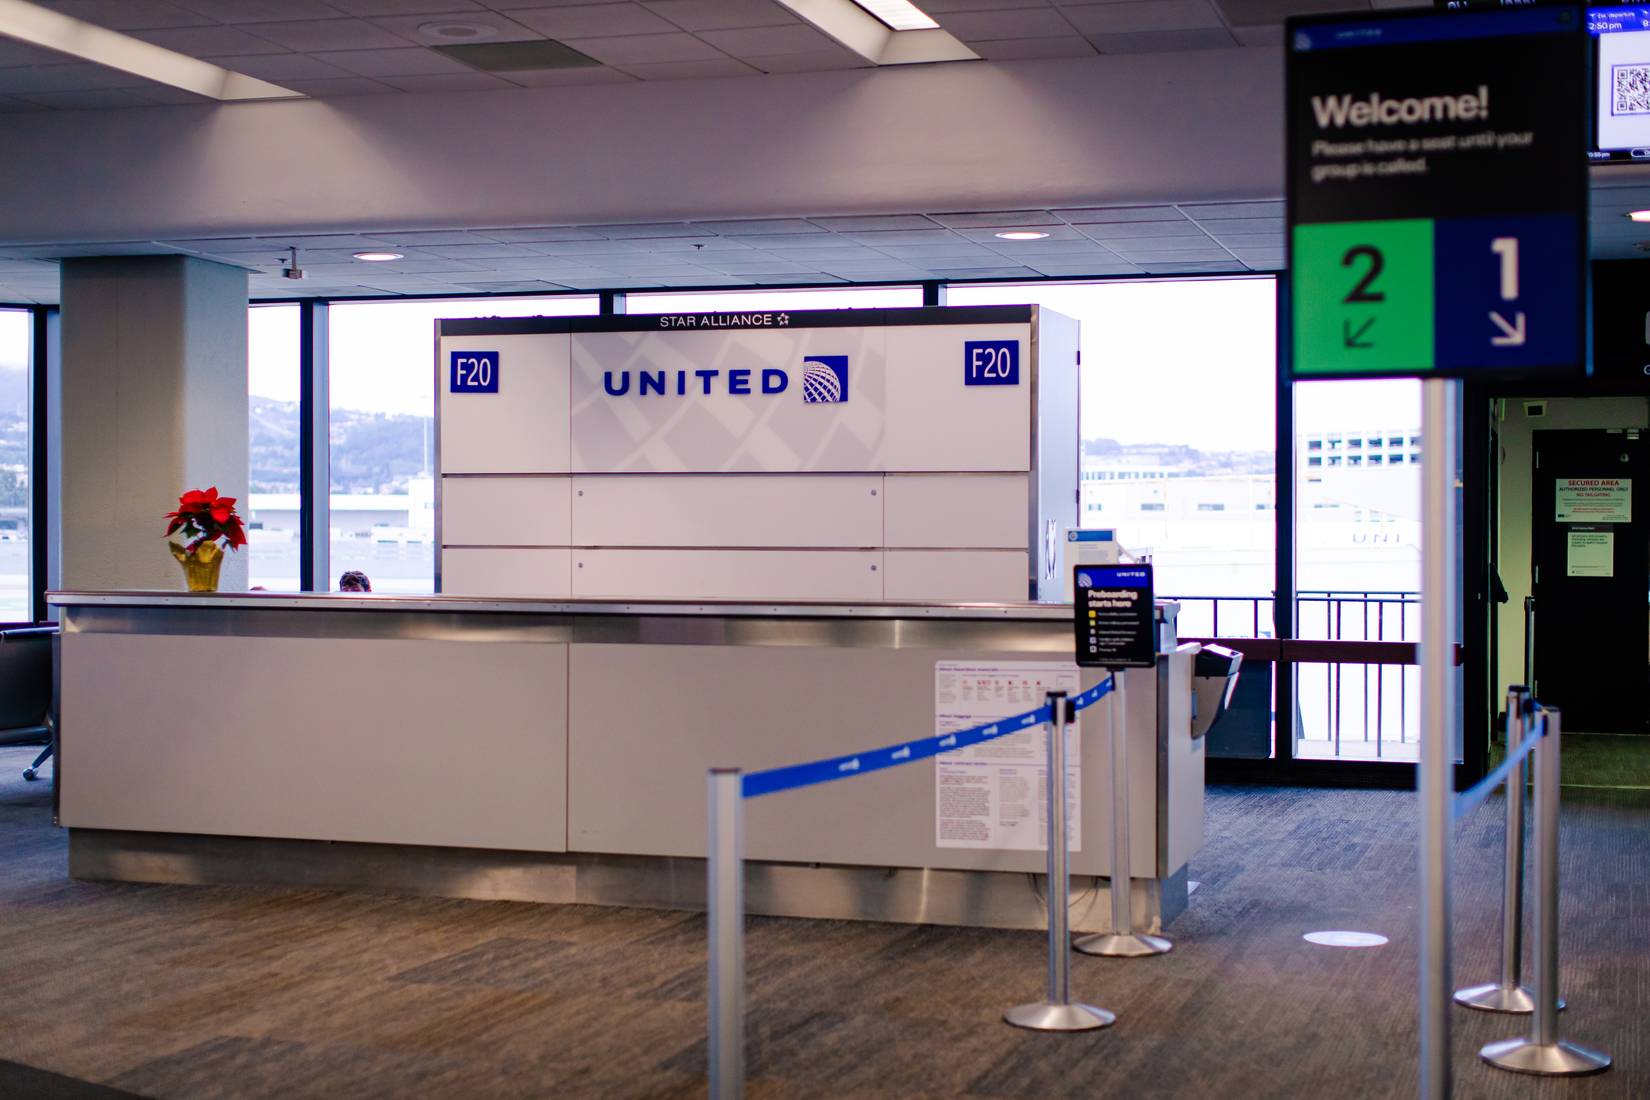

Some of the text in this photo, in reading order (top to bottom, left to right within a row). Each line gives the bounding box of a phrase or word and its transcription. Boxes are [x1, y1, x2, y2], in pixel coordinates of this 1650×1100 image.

[1311, 85, 1489, 129] Welcome!
[1312, 131, 1534, 157] Please have a seat until your
[1311, 162, 1359, 182] group
[1362, 160, 1375, 174] is
[1340, 243, 1386, 304] 2
[1490, 236, 1519, 301] 1
[659, 313, 773, 328] STAR ALLIANCE
[457, 358, 491, 386] F20
[973, 347, 1011, 378] F20
[604, 368, 789, 397] UNITED
[1088, 589, 1138, 600] Preboarding
[1112, 599, 1132, 607] here
